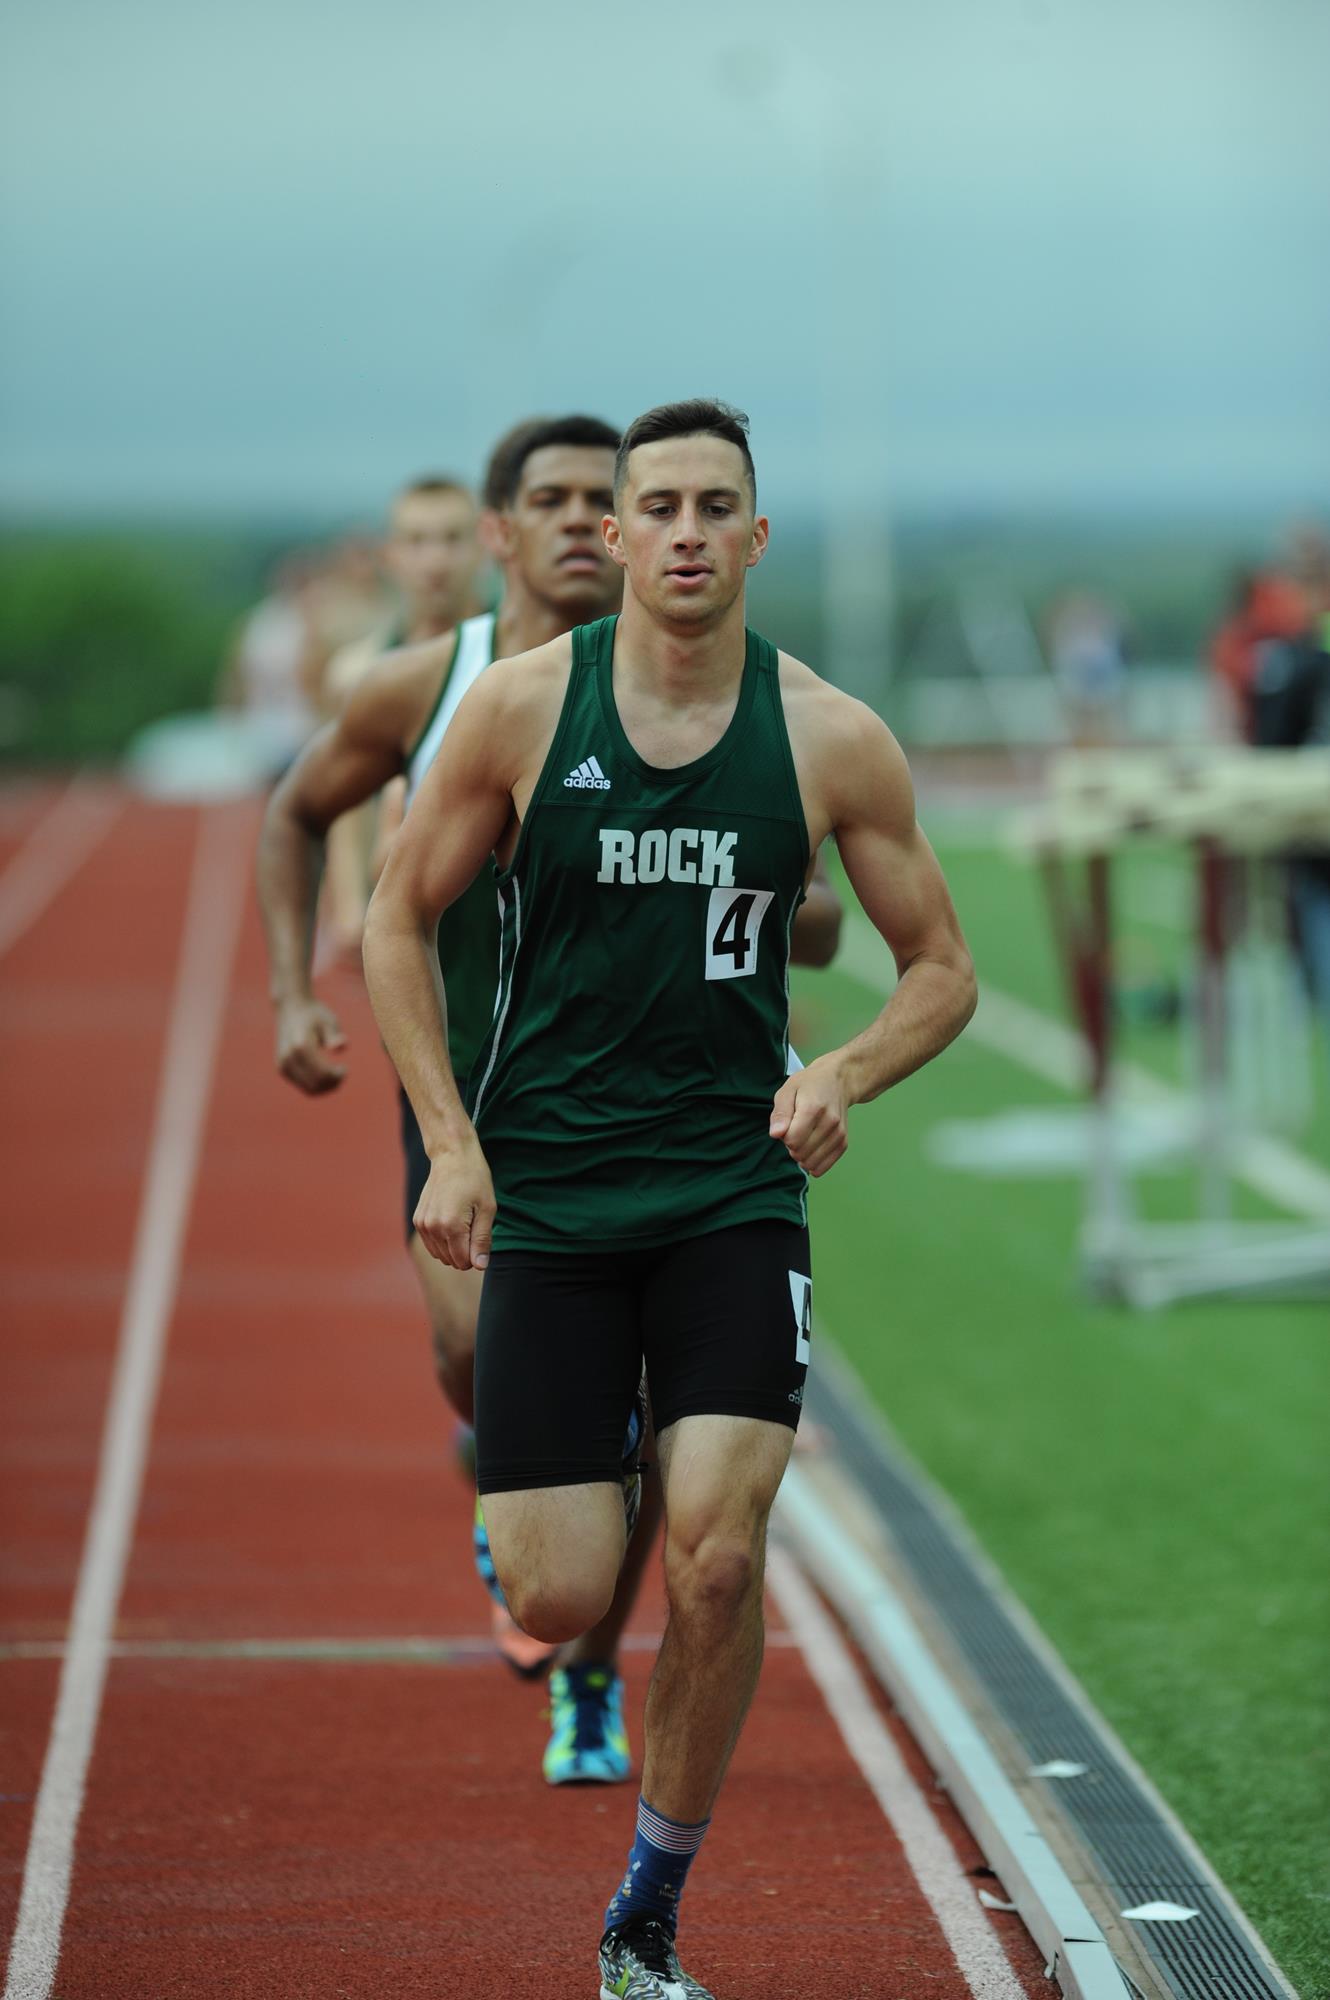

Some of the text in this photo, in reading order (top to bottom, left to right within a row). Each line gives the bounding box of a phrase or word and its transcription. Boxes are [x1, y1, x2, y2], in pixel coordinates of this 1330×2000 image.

[563, 776, 611, 790] adidas
[597, 828, 738, 887] ROCK
[712, 893, 757, 970] 4
